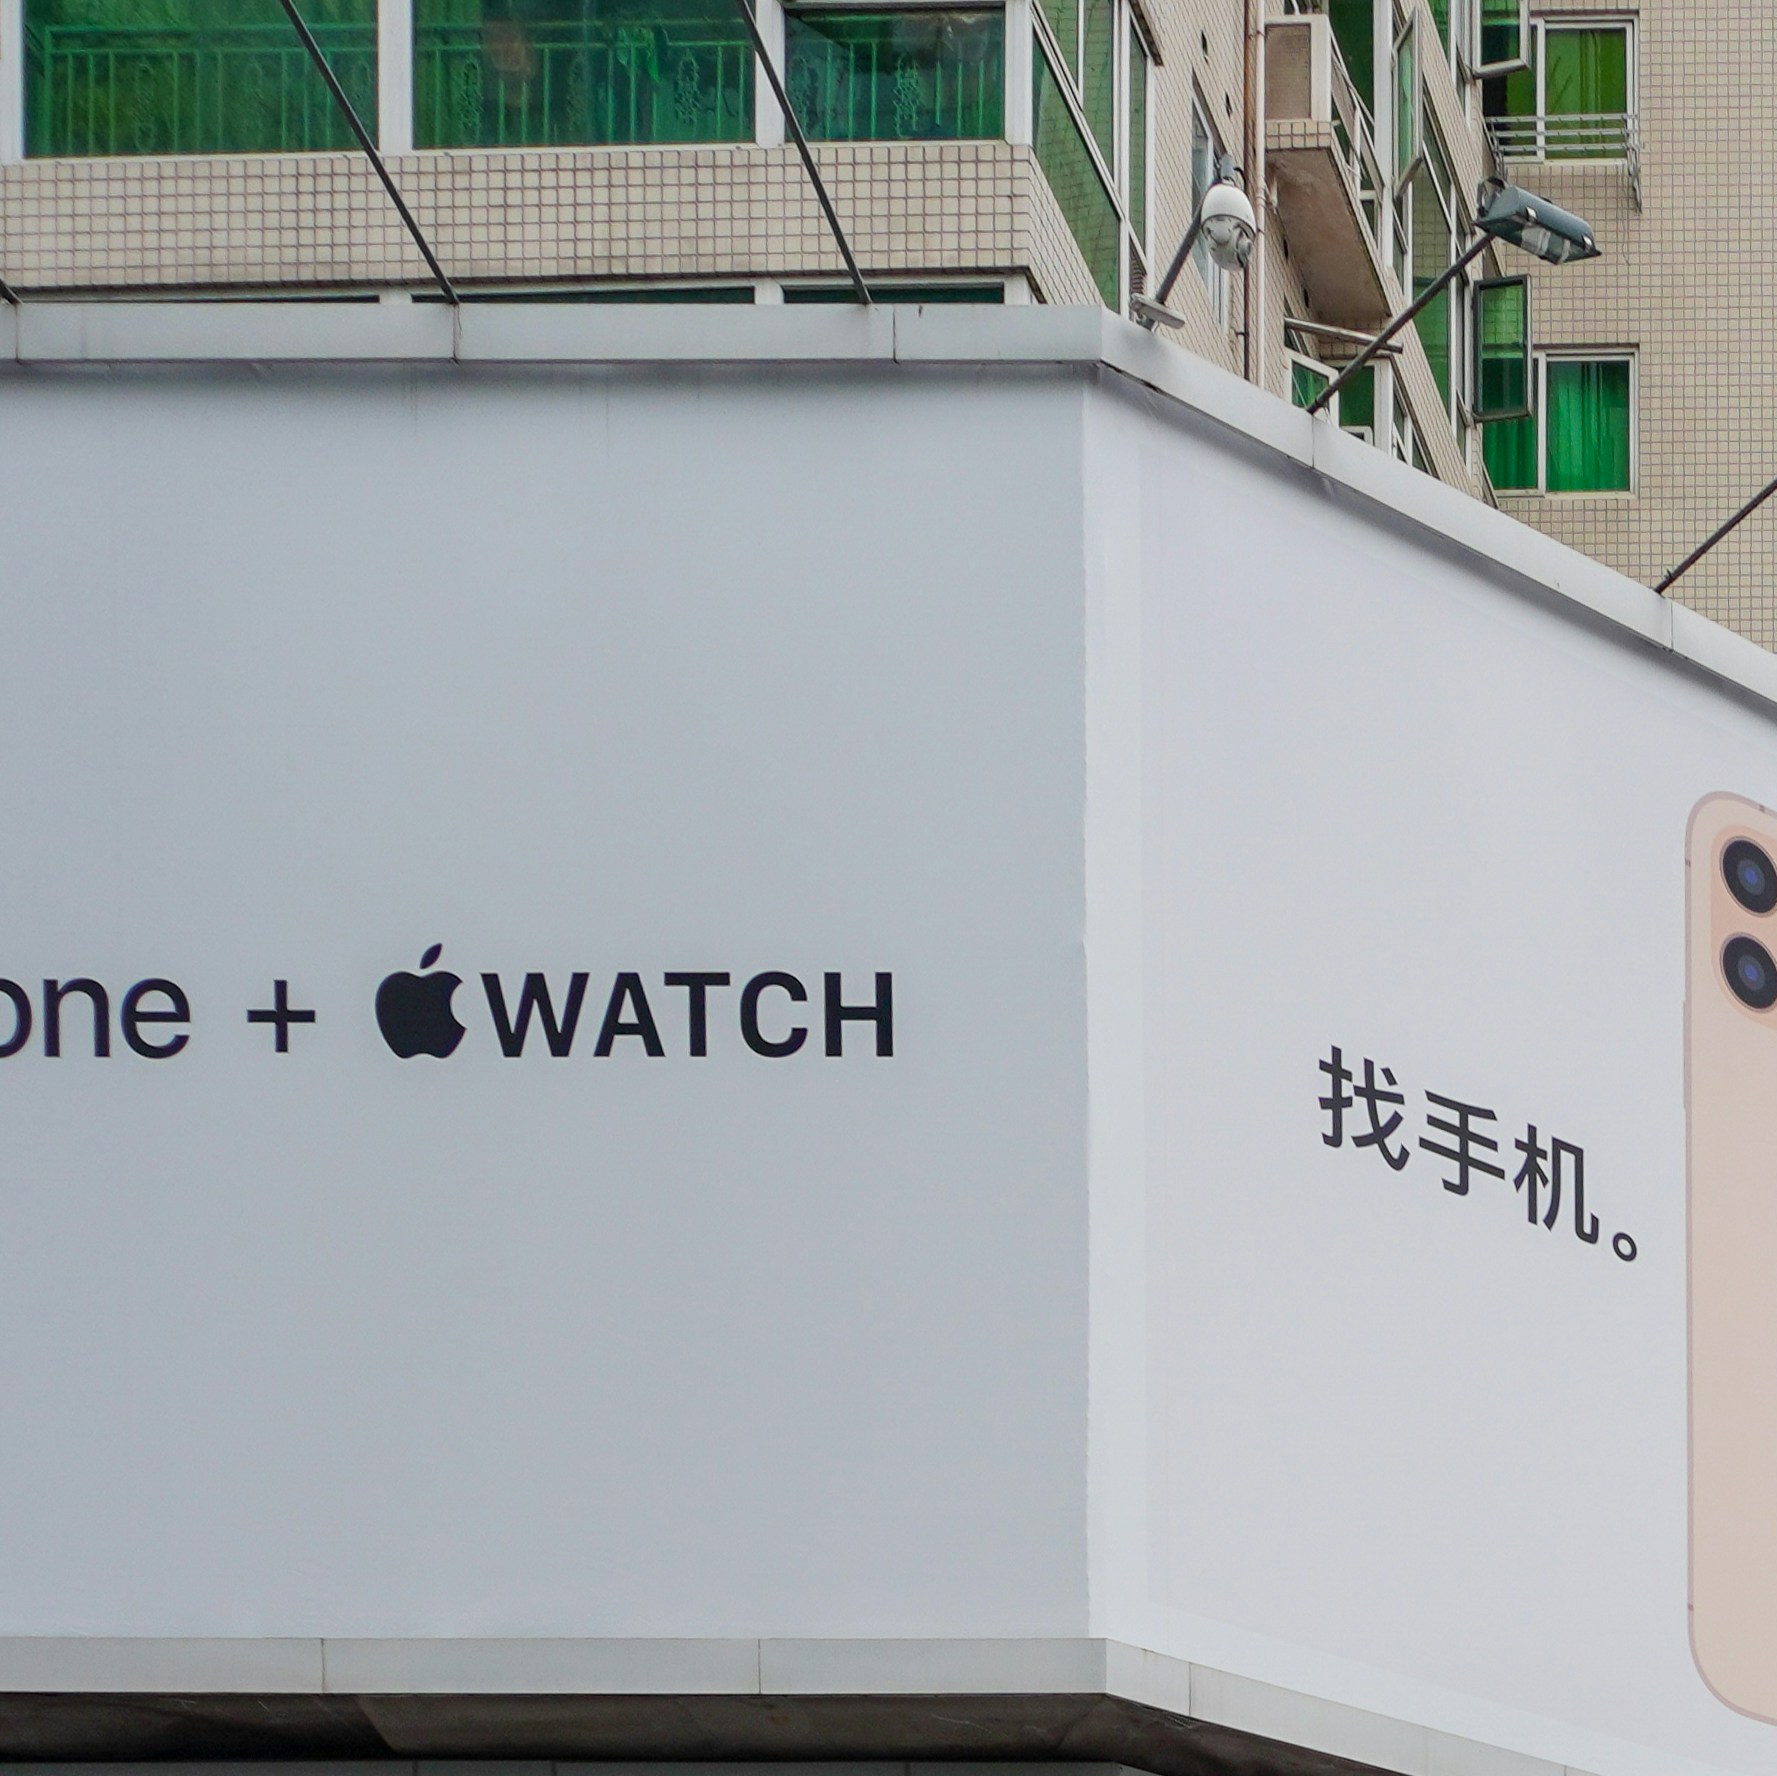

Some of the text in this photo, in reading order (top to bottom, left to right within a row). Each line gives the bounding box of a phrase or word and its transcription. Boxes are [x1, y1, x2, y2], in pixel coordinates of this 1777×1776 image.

[480, 971, 895, 1058] WATCH
[1318, 1044, 1638, 1262] 找手机。
